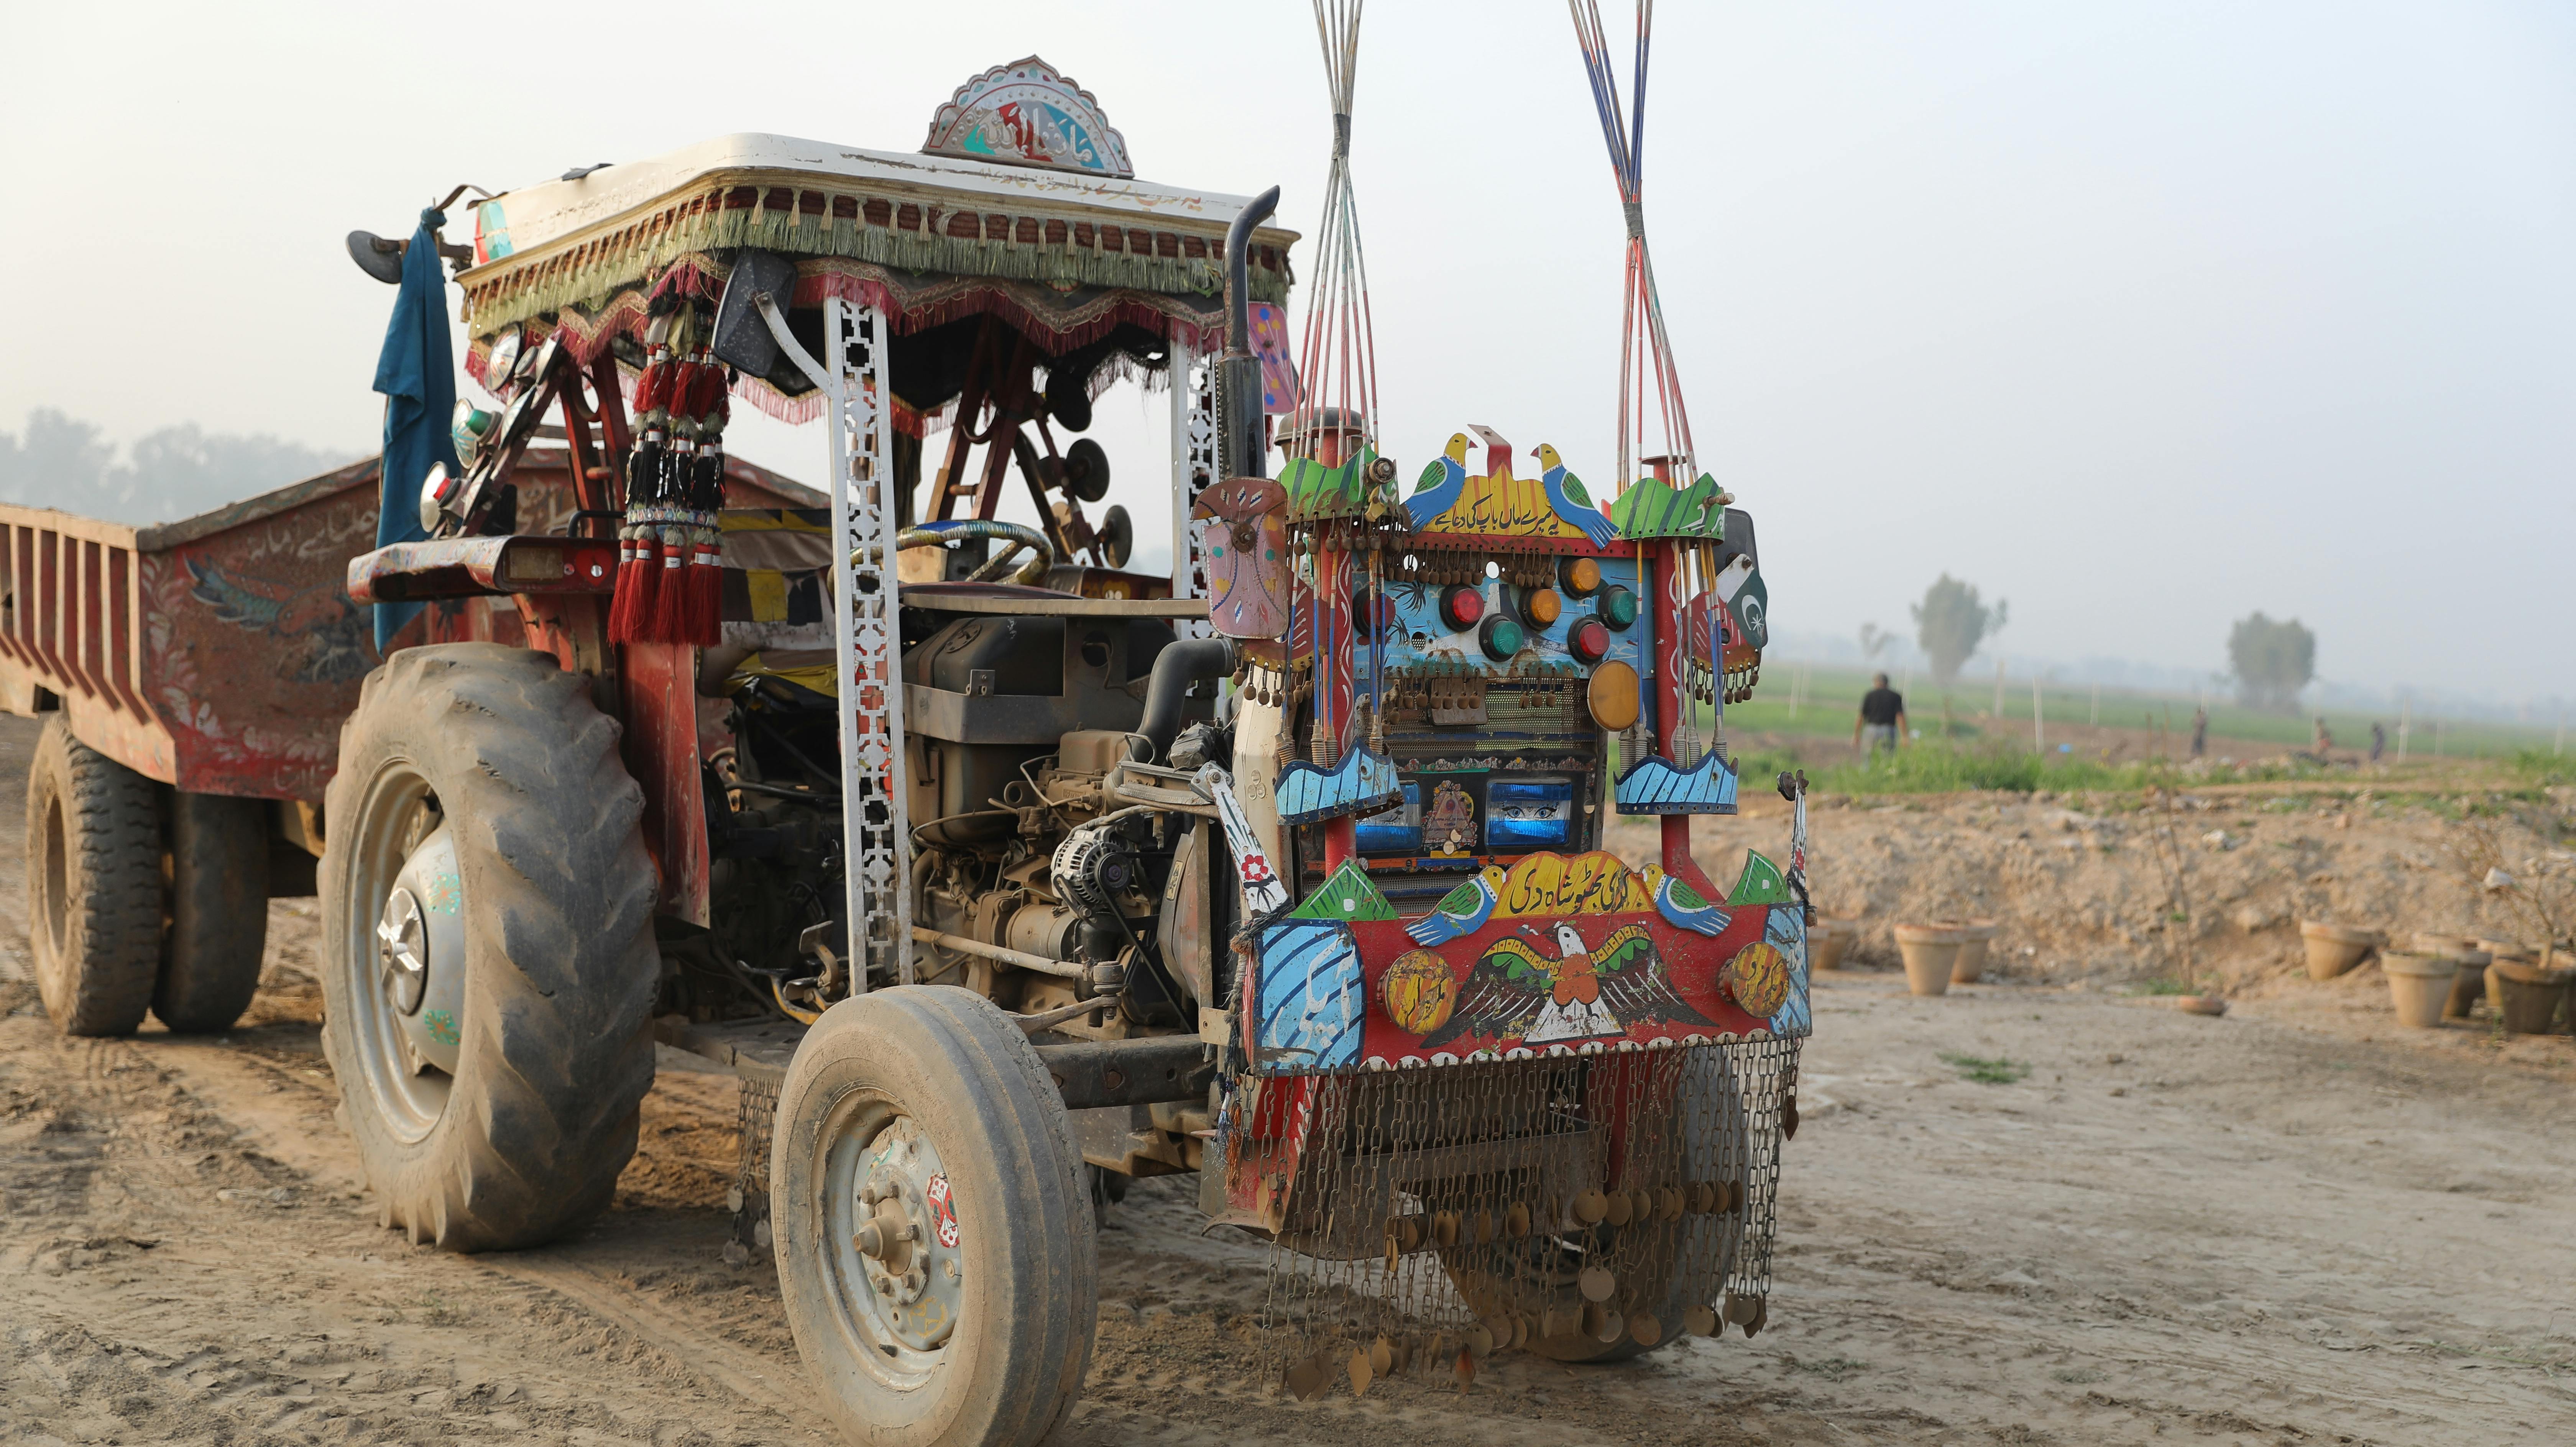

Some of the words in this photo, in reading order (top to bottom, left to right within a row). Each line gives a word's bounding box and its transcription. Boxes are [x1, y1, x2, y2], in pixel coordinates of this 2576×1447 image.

[1435, 514, 1451, 533] ہے
[1452, 504, 1465, 528] دعا
[1467, 493, 1493, 529] کی
[1476, 506, 1498, 533] باپ
[1498, 502, 1520, 530] ماں
[1520, 509, 1552, 536] میرے
[1547, 519, 1560, 536] یہ
[1509, 868, 1543, 914] دی
[1545, 863, 1575, 907] شاہ
